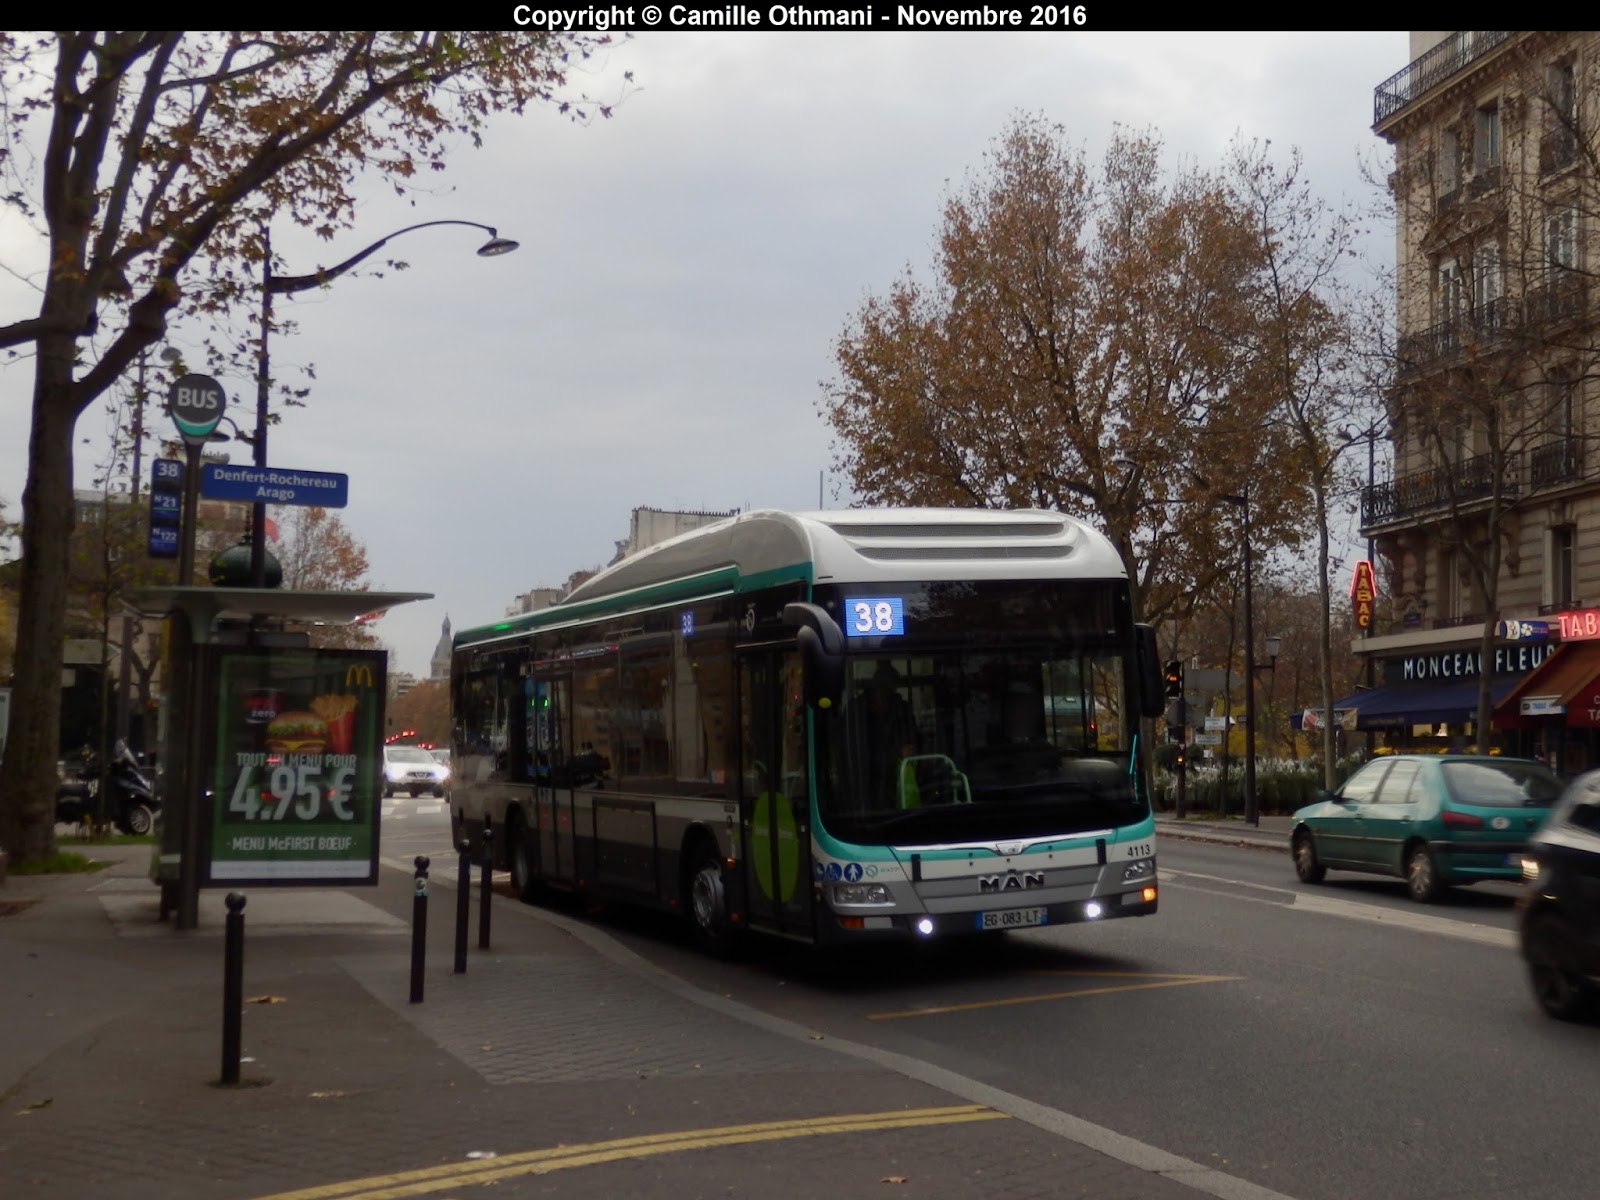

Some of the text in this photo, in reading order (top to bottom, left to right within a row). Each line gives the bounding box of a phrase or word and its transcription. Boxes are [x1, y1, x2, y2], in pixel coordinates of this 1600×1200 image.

[177, 388, 218, 409] BUS
[158, 463, 178, 477] 38
[214, 469, 337, 488] Denfert-Rochereau
[256, 487, 295, 500] Arago
[1356, 565, 1371, 627] TABAC
[682, 614, 692, 634] 38
[854, 602, 893, 632] 38
[1558, 613, 1597, 637] TAB
[236, 753, 266, 767] TOUT
[288, 754, 322, 768] MENU
[325, 754, 357, 768] POUR
[229, 766, 356, 821] 4.95 €
[232, 837, 352, 850] MENU McFIRST BŒUF
[1127, 845, 1151, 857] 4113
[977, 873, 1045, 892] MAN
